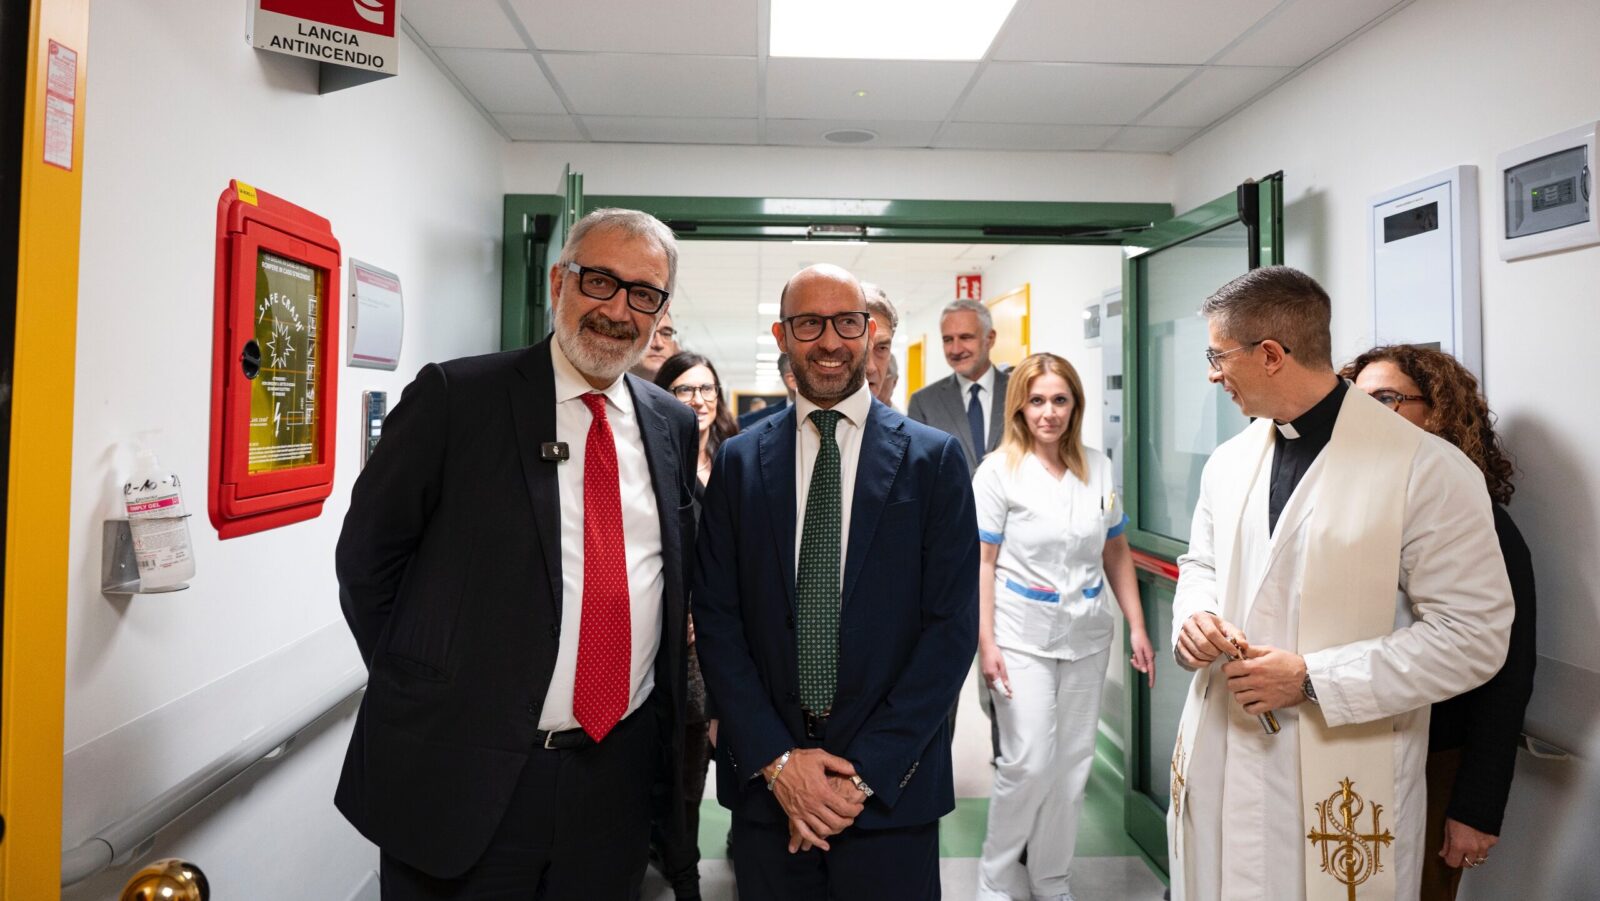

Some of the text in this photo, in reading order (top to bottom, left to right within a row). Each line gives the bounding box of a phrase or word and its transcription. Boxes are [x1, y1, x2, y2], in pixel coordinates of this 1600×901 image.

[298, 23, 359, 47] LANCIA
[270, 35, 384, 68] ANTINCENDIO
[258, 292, 303, 332] SAFE CRASH
[148, 502, 160, 510] GEL
